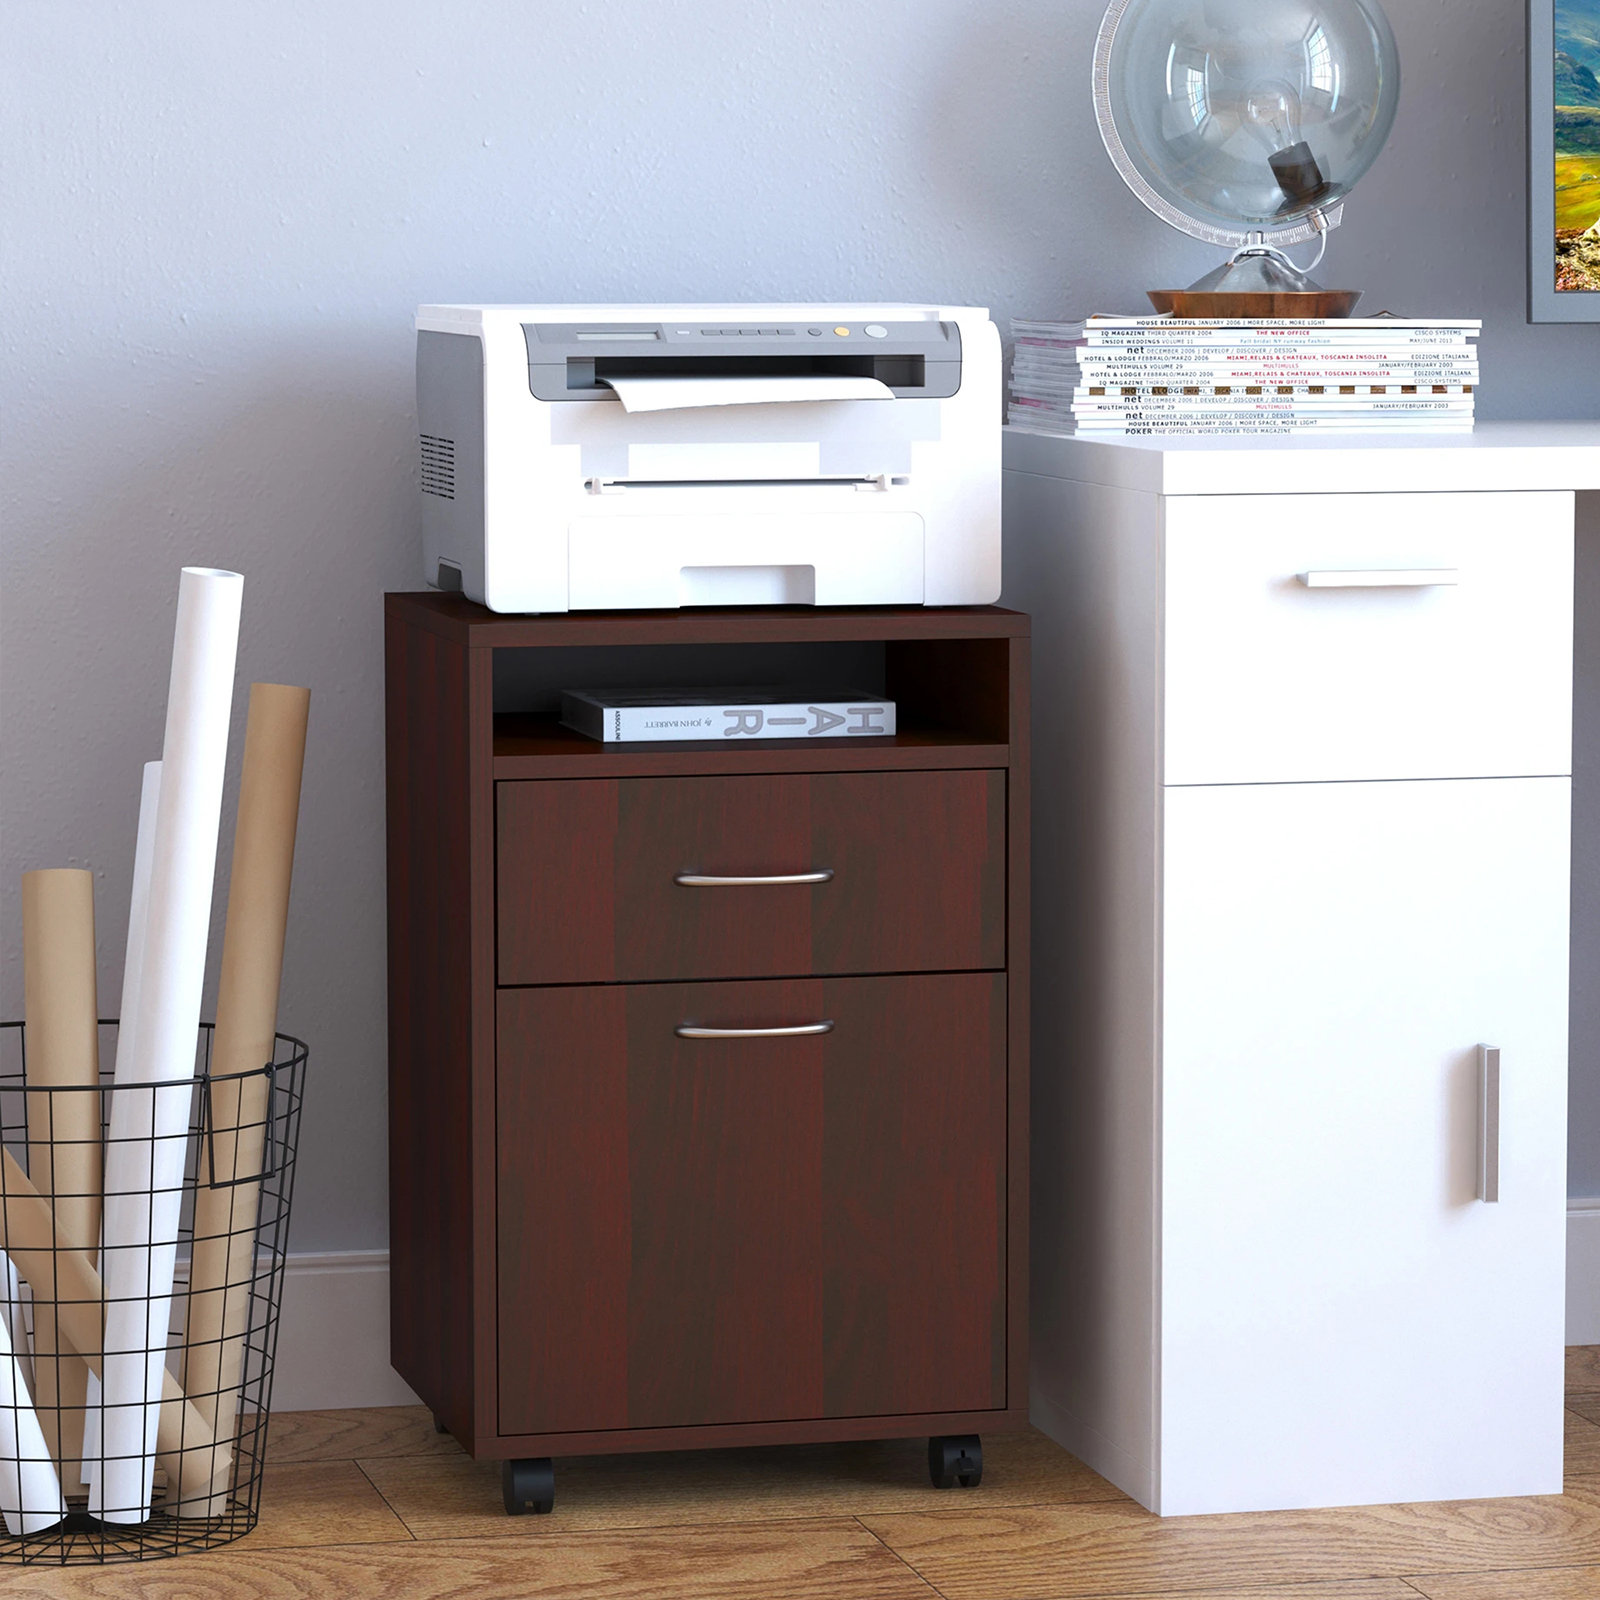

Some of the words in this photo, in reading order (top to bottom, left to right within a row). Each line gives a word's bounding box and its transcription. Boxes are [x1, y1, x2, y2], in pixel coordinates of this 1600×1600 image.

[644, 720, 679, 729] BARRETT
[680, 718, 702, 727] JOHN
[723, 706, 884, 737] HAIR
